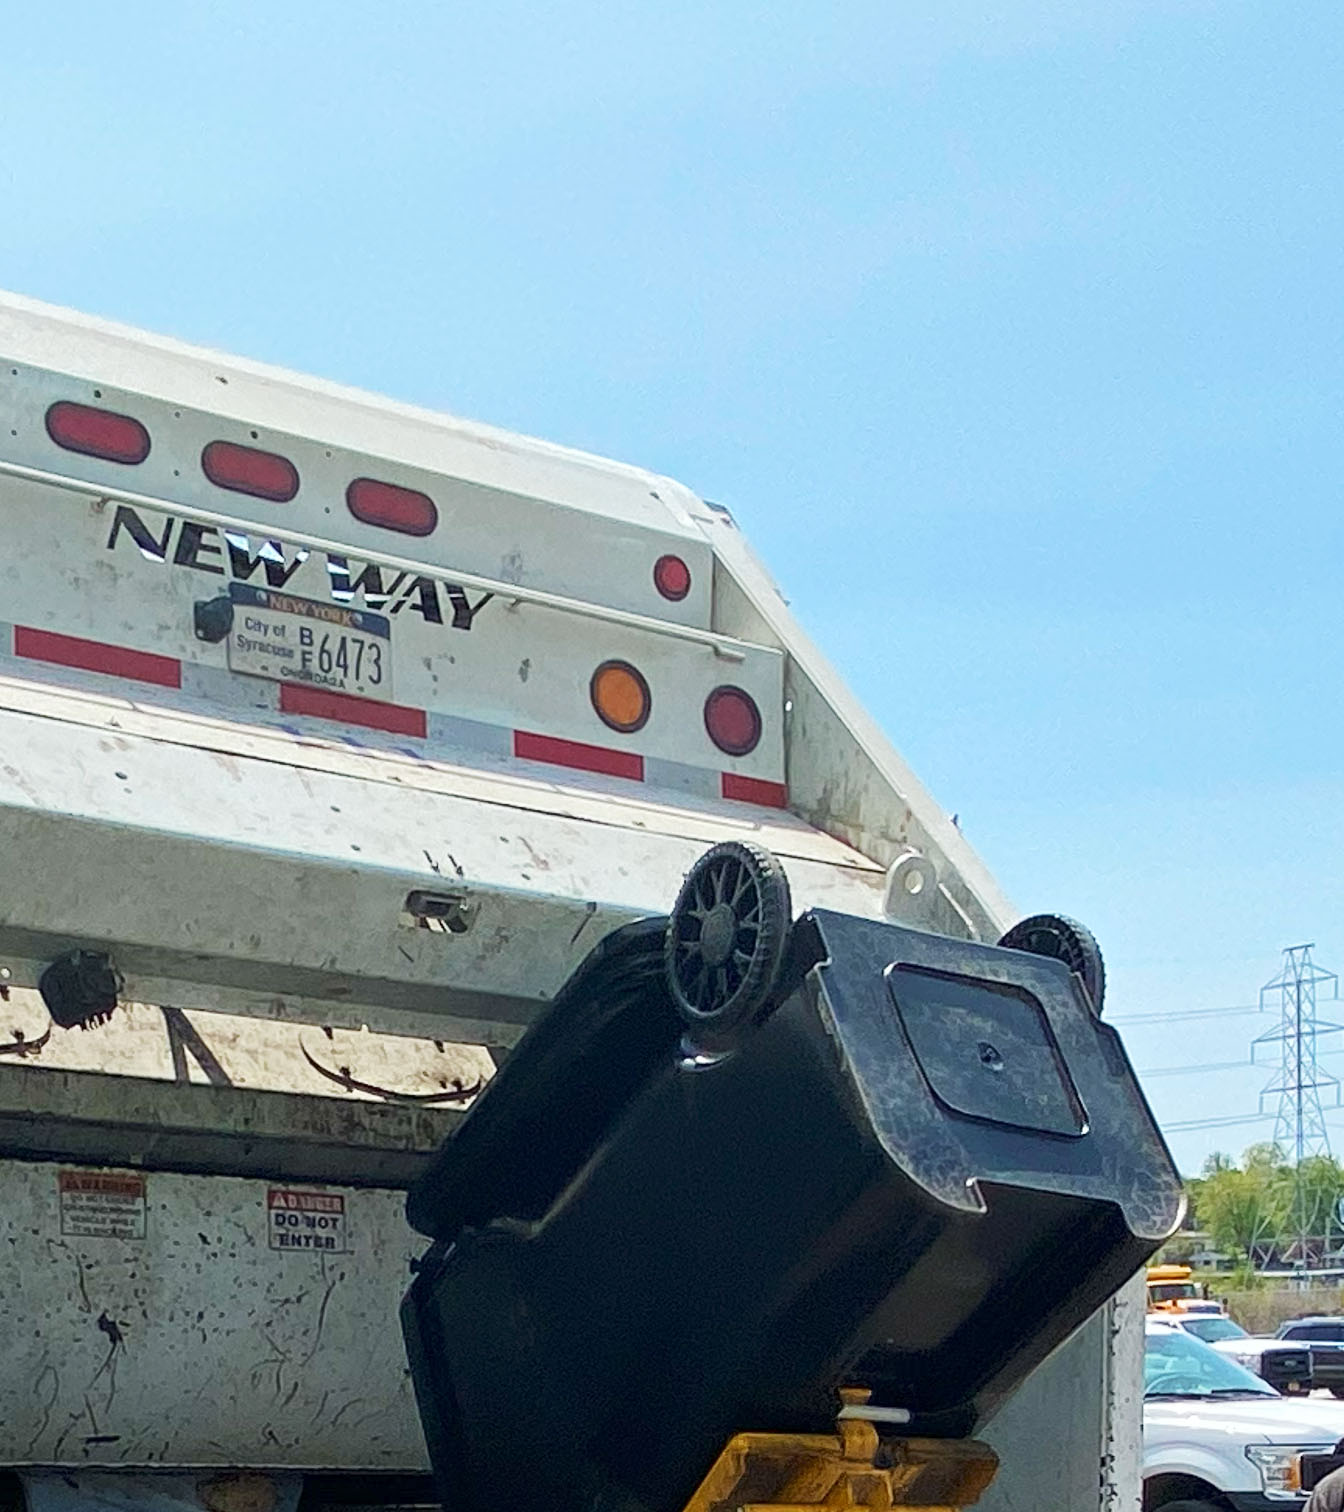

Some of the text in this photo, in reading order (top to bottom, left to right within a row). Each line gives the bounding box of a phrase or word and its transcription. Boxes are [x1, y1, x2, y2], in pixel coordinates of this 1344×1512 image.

[106, 504, 495, 632] NEW WAY
[268, 595, 353, 626] NEW YORK
[244, 616, 287, 638] City of
[236, 634, 295, 659] Syracuse
[318, 633, 383, 685] 6473
[274, 1213, 340, 1230] DO NOT
[277, 1233, 337, 1249] ENTER
